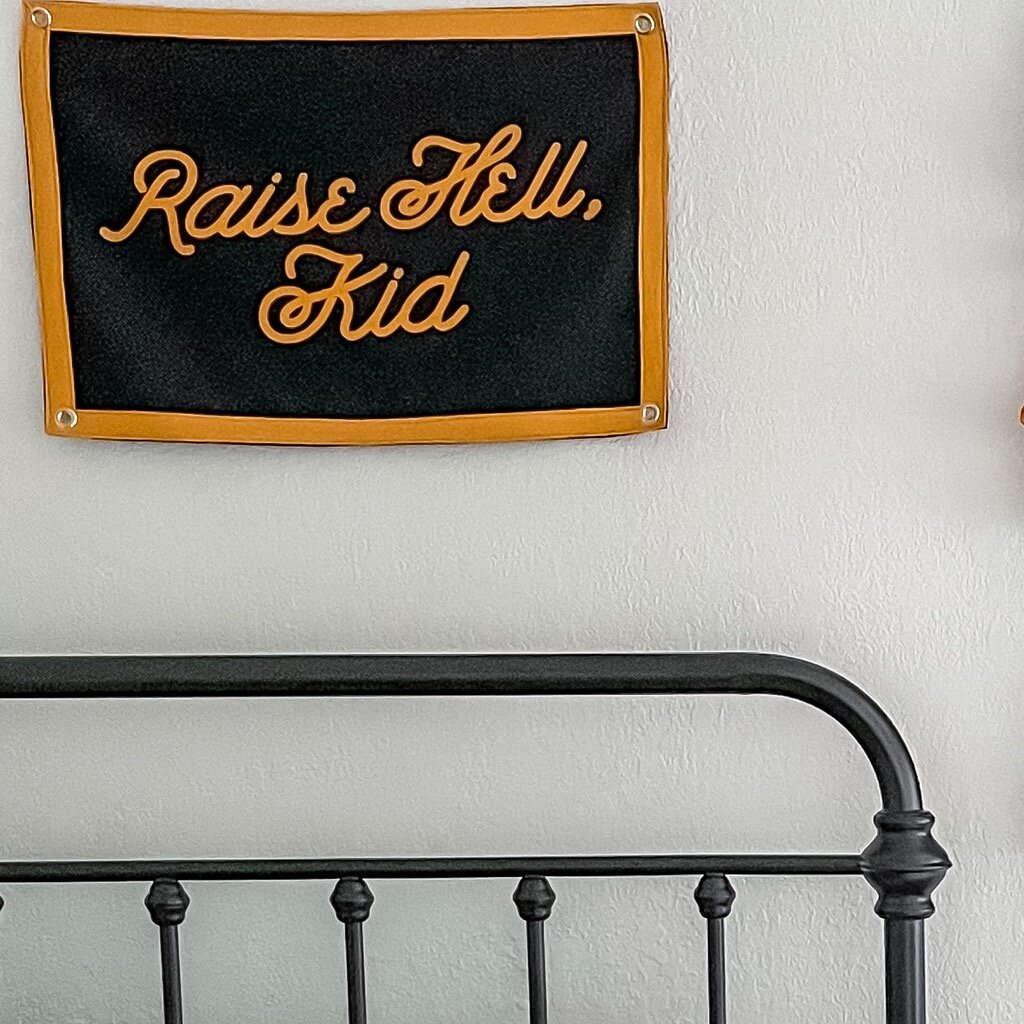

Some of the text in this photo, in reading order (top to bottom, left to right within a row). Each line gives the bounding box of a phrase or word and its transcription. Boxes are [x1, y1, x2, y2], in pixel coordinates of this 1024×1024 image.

[98, 123, 604, 256] Raise Hell,
[258, 242, 471, 345] Kid
